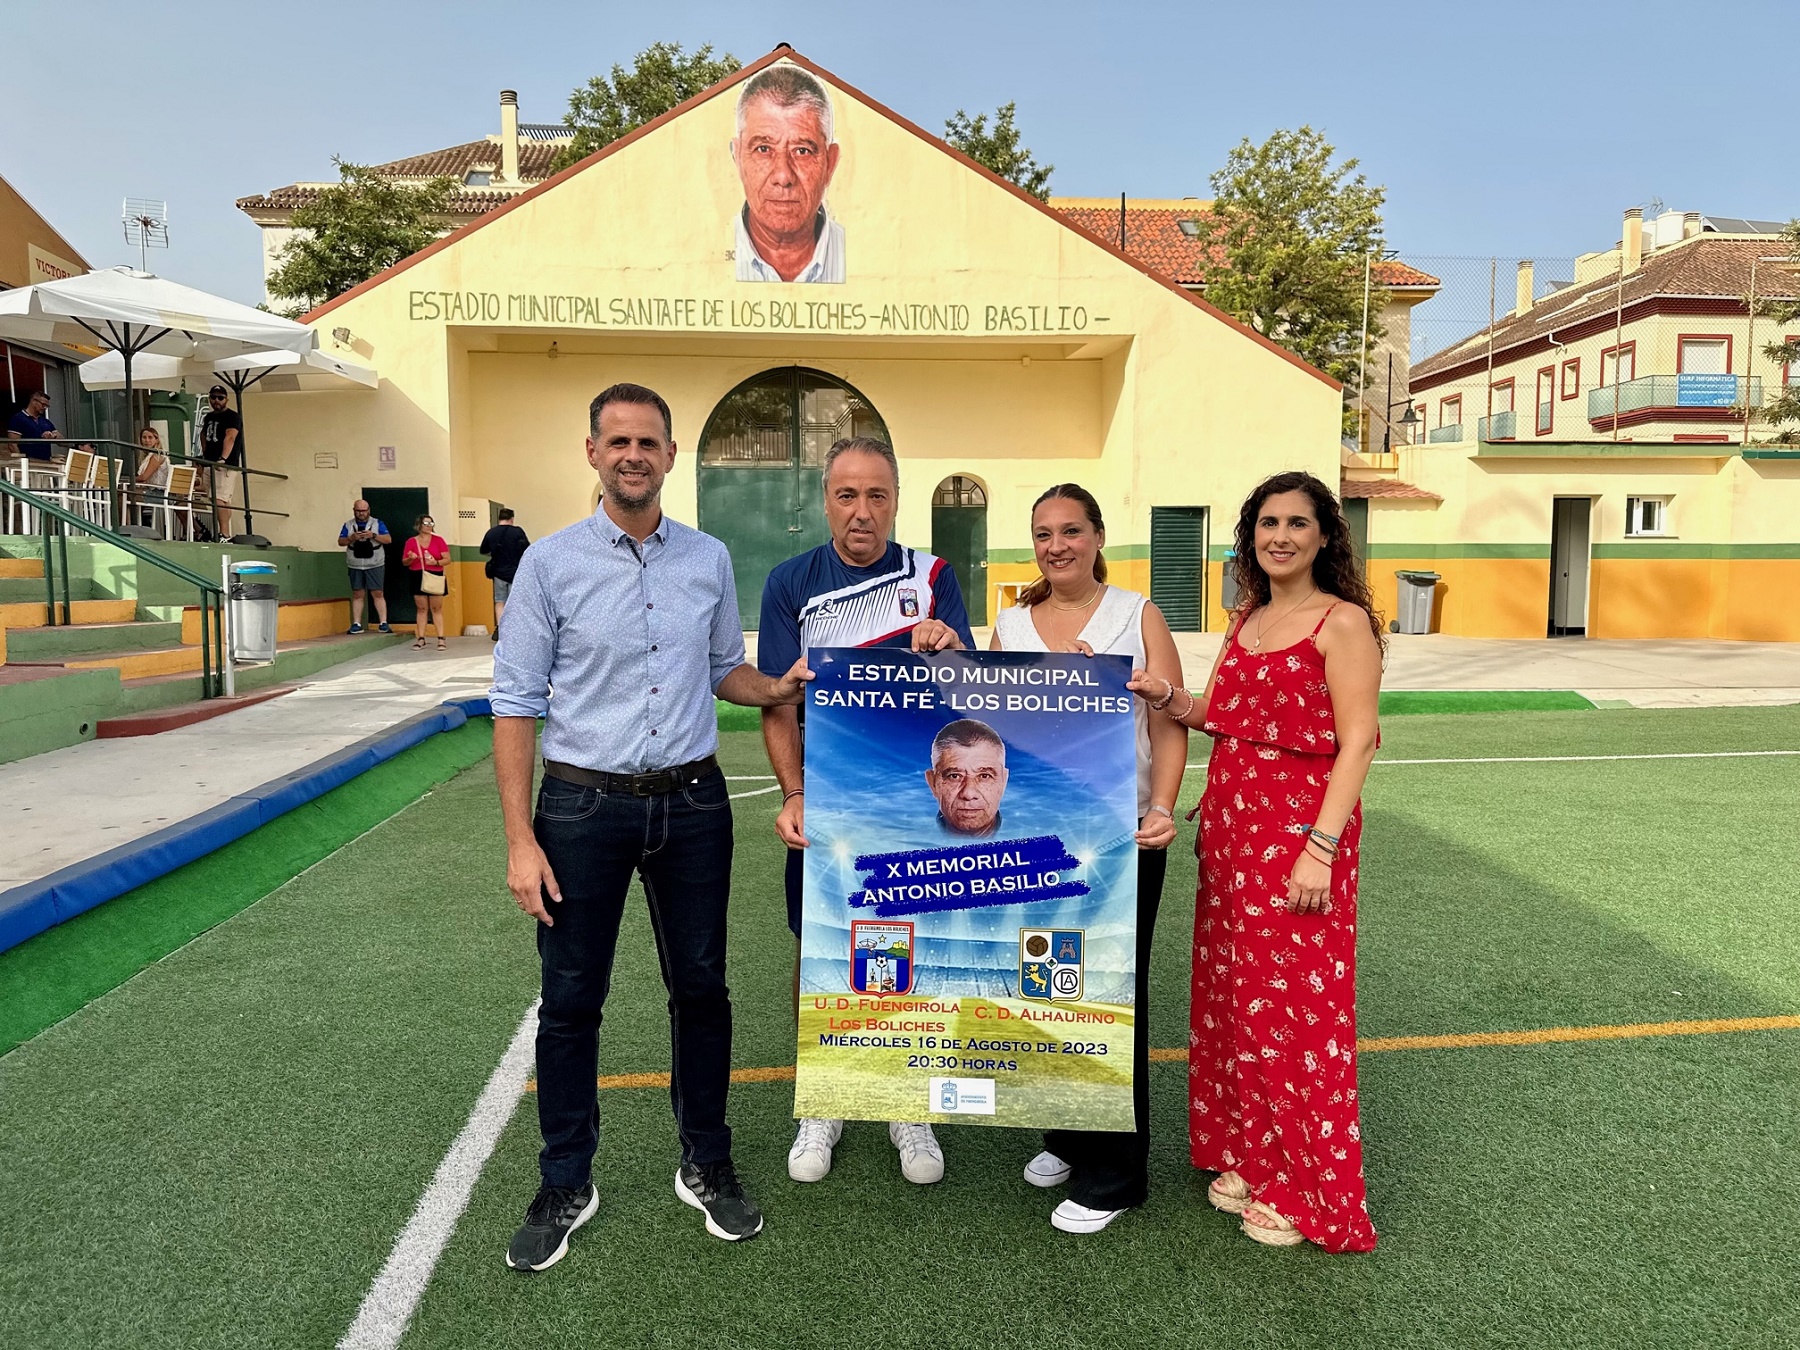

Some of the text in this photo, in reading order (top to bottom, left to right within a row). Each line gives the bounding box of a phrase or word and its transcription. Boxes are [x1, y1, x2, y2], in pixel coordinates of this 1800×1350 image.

[409, 290, 500, 321] ESTADIO
[507, 293, 607, 325] MUNICIPAL
[702, 299, 724, 327] DE
[731, 300, 766, 328] LOS
[985, 304, 1088, 332] BASILIO
[848, 664, 1100, 687] ESTADIO MUNICIPAL
[814, 690, 897, 709] SANTA
[902, 688, 935, 710] FÉ
[951, 693, 1000, 711] LOS
[1006, 694, 1130, 714] BOLICHES
[887, 851, 1031, 879] X MEMORIAL
[862, 871, 1061, 905] ANTONIO BASILIO
[858, 999, 961, 1013] FUENGIROLA
[1020, 1008, 1115, 1025] ALHAURINO
[829, 1017, 946, 1032] LOS BOLICHES
[819, 1033, 1108, 1055] MIÉRCOLES 16 DE AGOSTO DE 2023
[907, 1055, 1017, 1071] 20:30 HORAS
